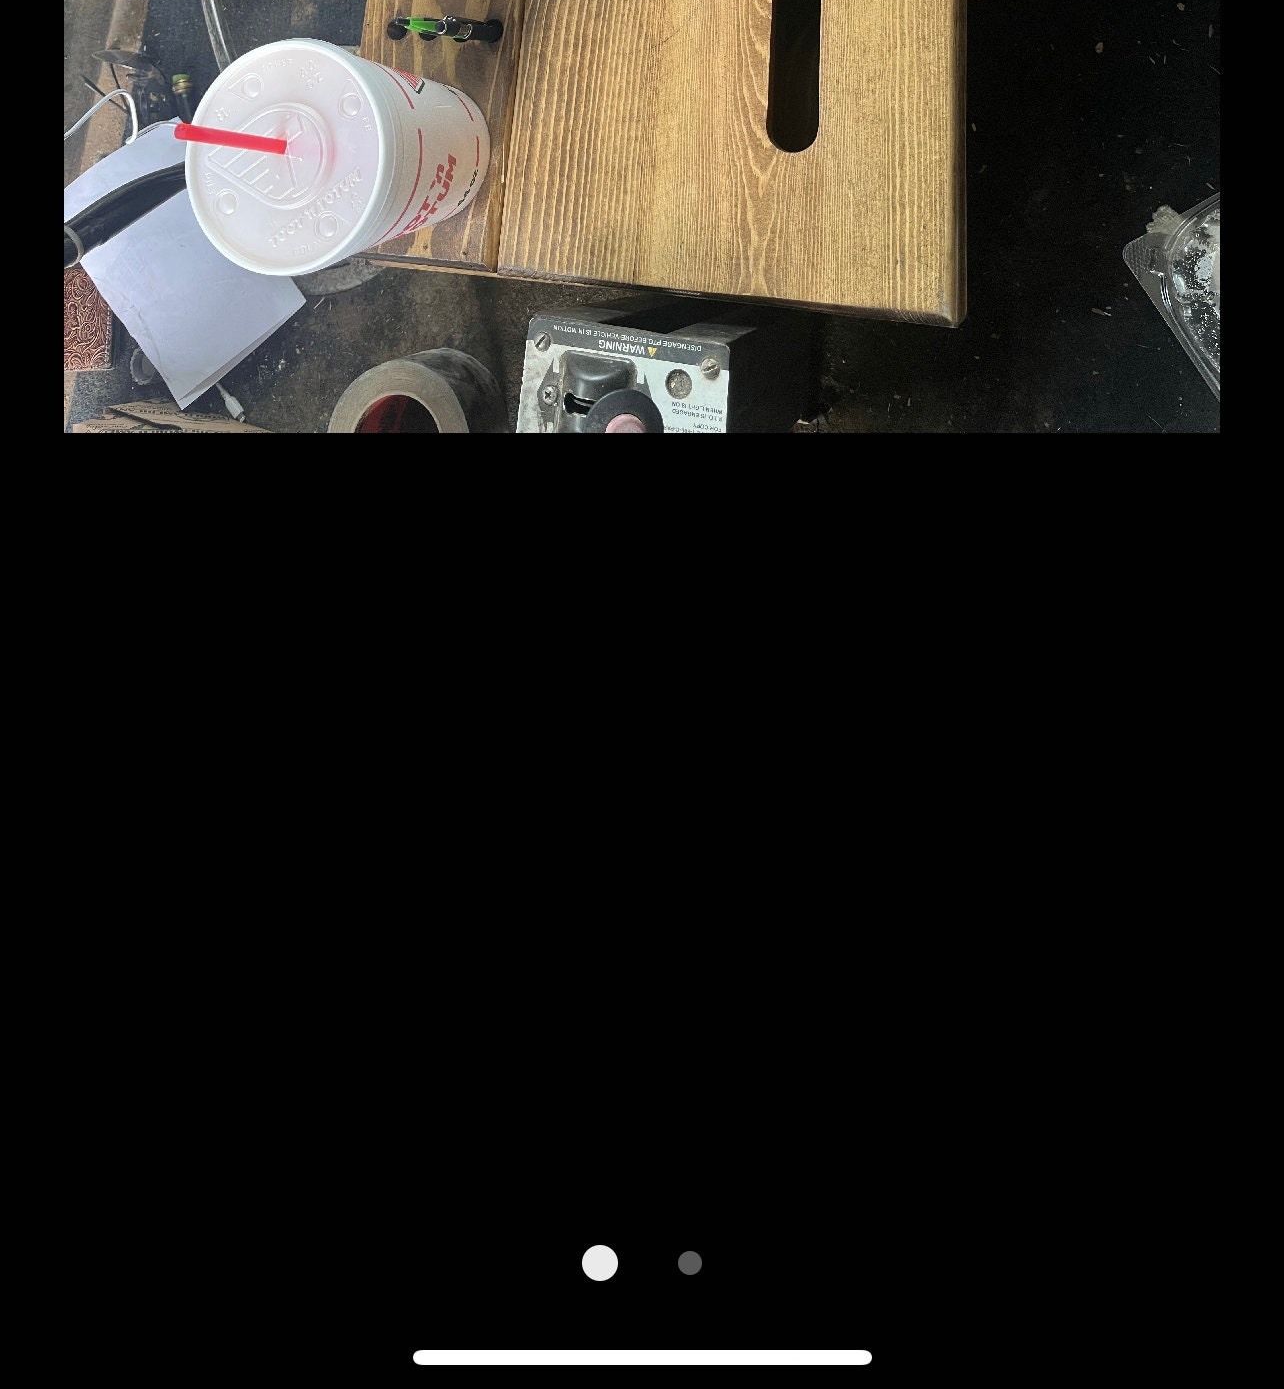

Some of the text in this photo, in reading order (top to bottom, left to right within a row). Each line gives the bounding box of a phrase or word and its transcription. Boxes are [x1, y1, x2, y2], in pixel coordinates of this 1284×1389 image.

[593, 331, 620, 341] VEHICLE
[621, 334, 647, 344] BEFORE
[598, 340, 646, 355] WARNING
[663, 342, 702, 352] DISENGAGE
